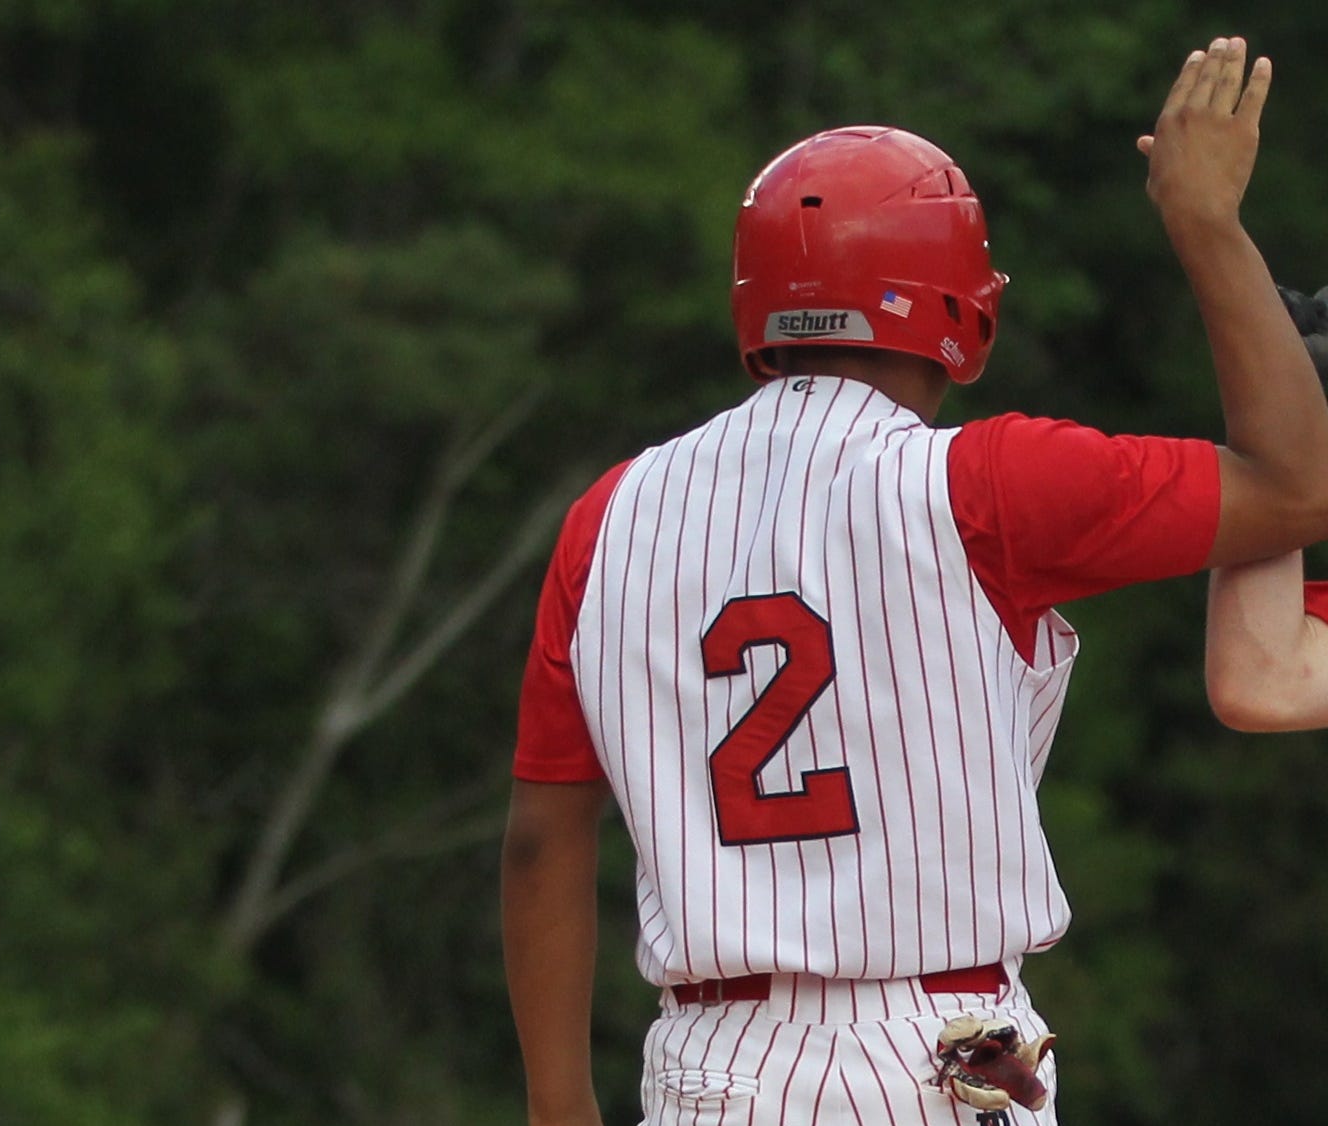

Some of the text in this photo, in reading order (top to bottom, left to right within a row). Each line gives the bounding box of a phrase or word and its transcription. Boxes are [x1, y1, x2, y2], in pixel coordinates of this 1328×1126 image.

[778, 311, 849, 332] schutt
[939, 336, 965, 368] schutt
[700, 591, 861, 846] 2
